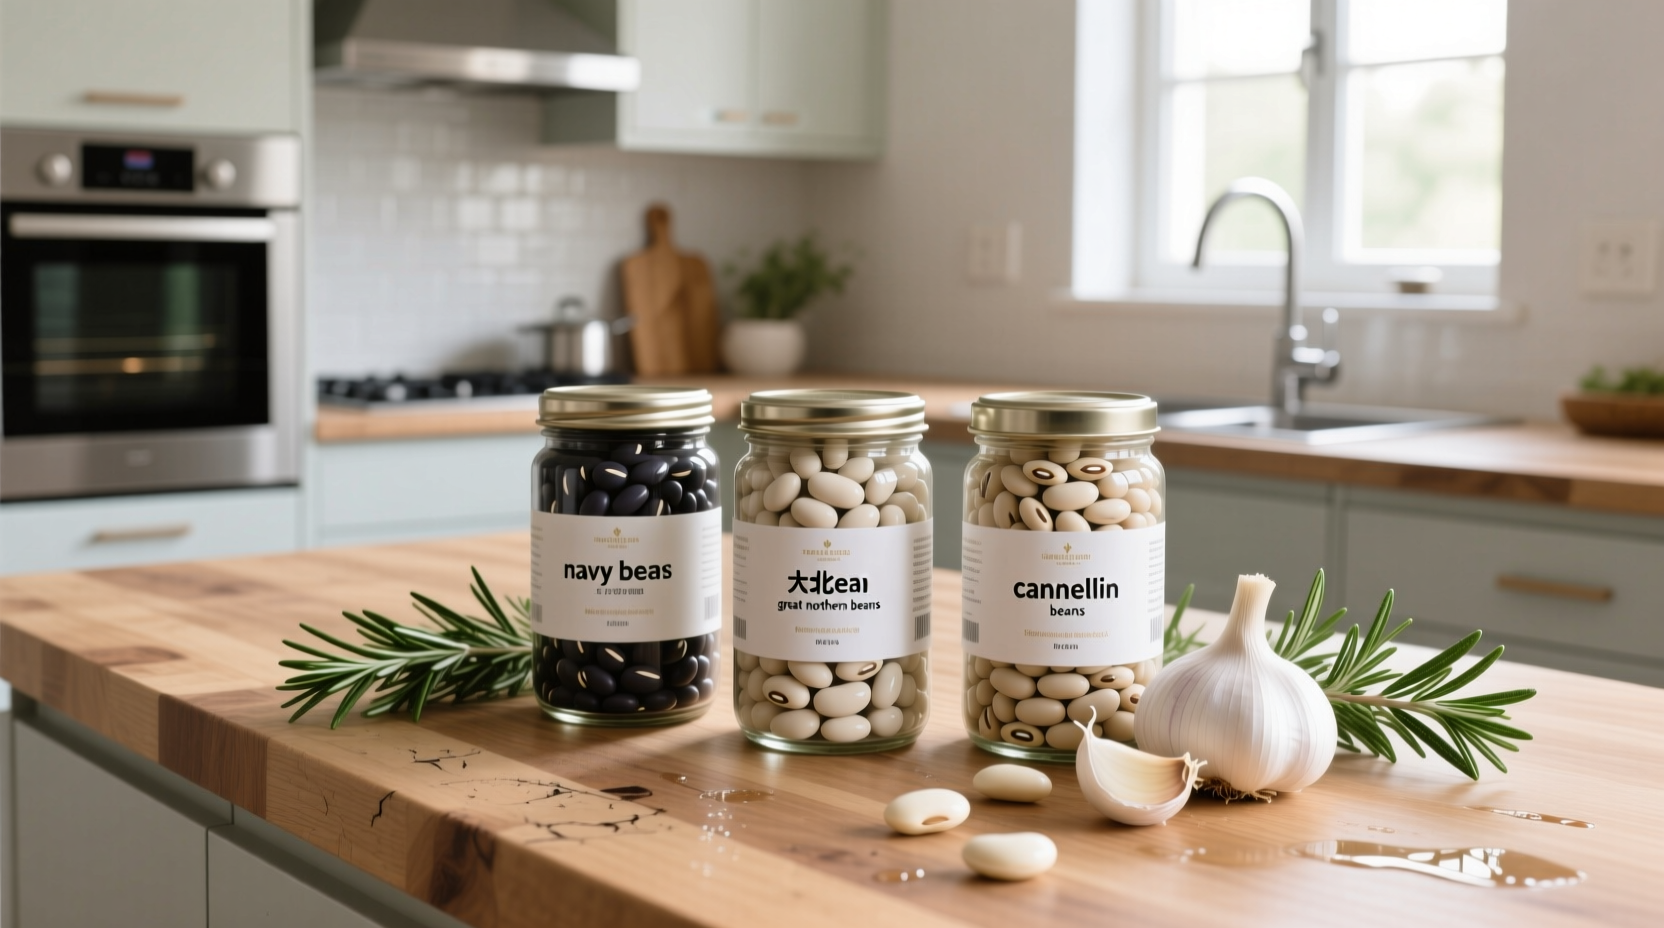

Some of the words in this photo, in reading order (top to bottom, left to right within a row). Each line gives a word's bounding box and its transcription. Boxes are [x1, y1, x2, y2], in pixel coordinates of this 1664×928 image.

[564, 563, 613, 586] navy
[619, 560, 672, 581] beas
[1013, 577, 1119, 599] cannellin
[777, 600, 803, 611] great
[1050, 604, 1085, 616] beans
